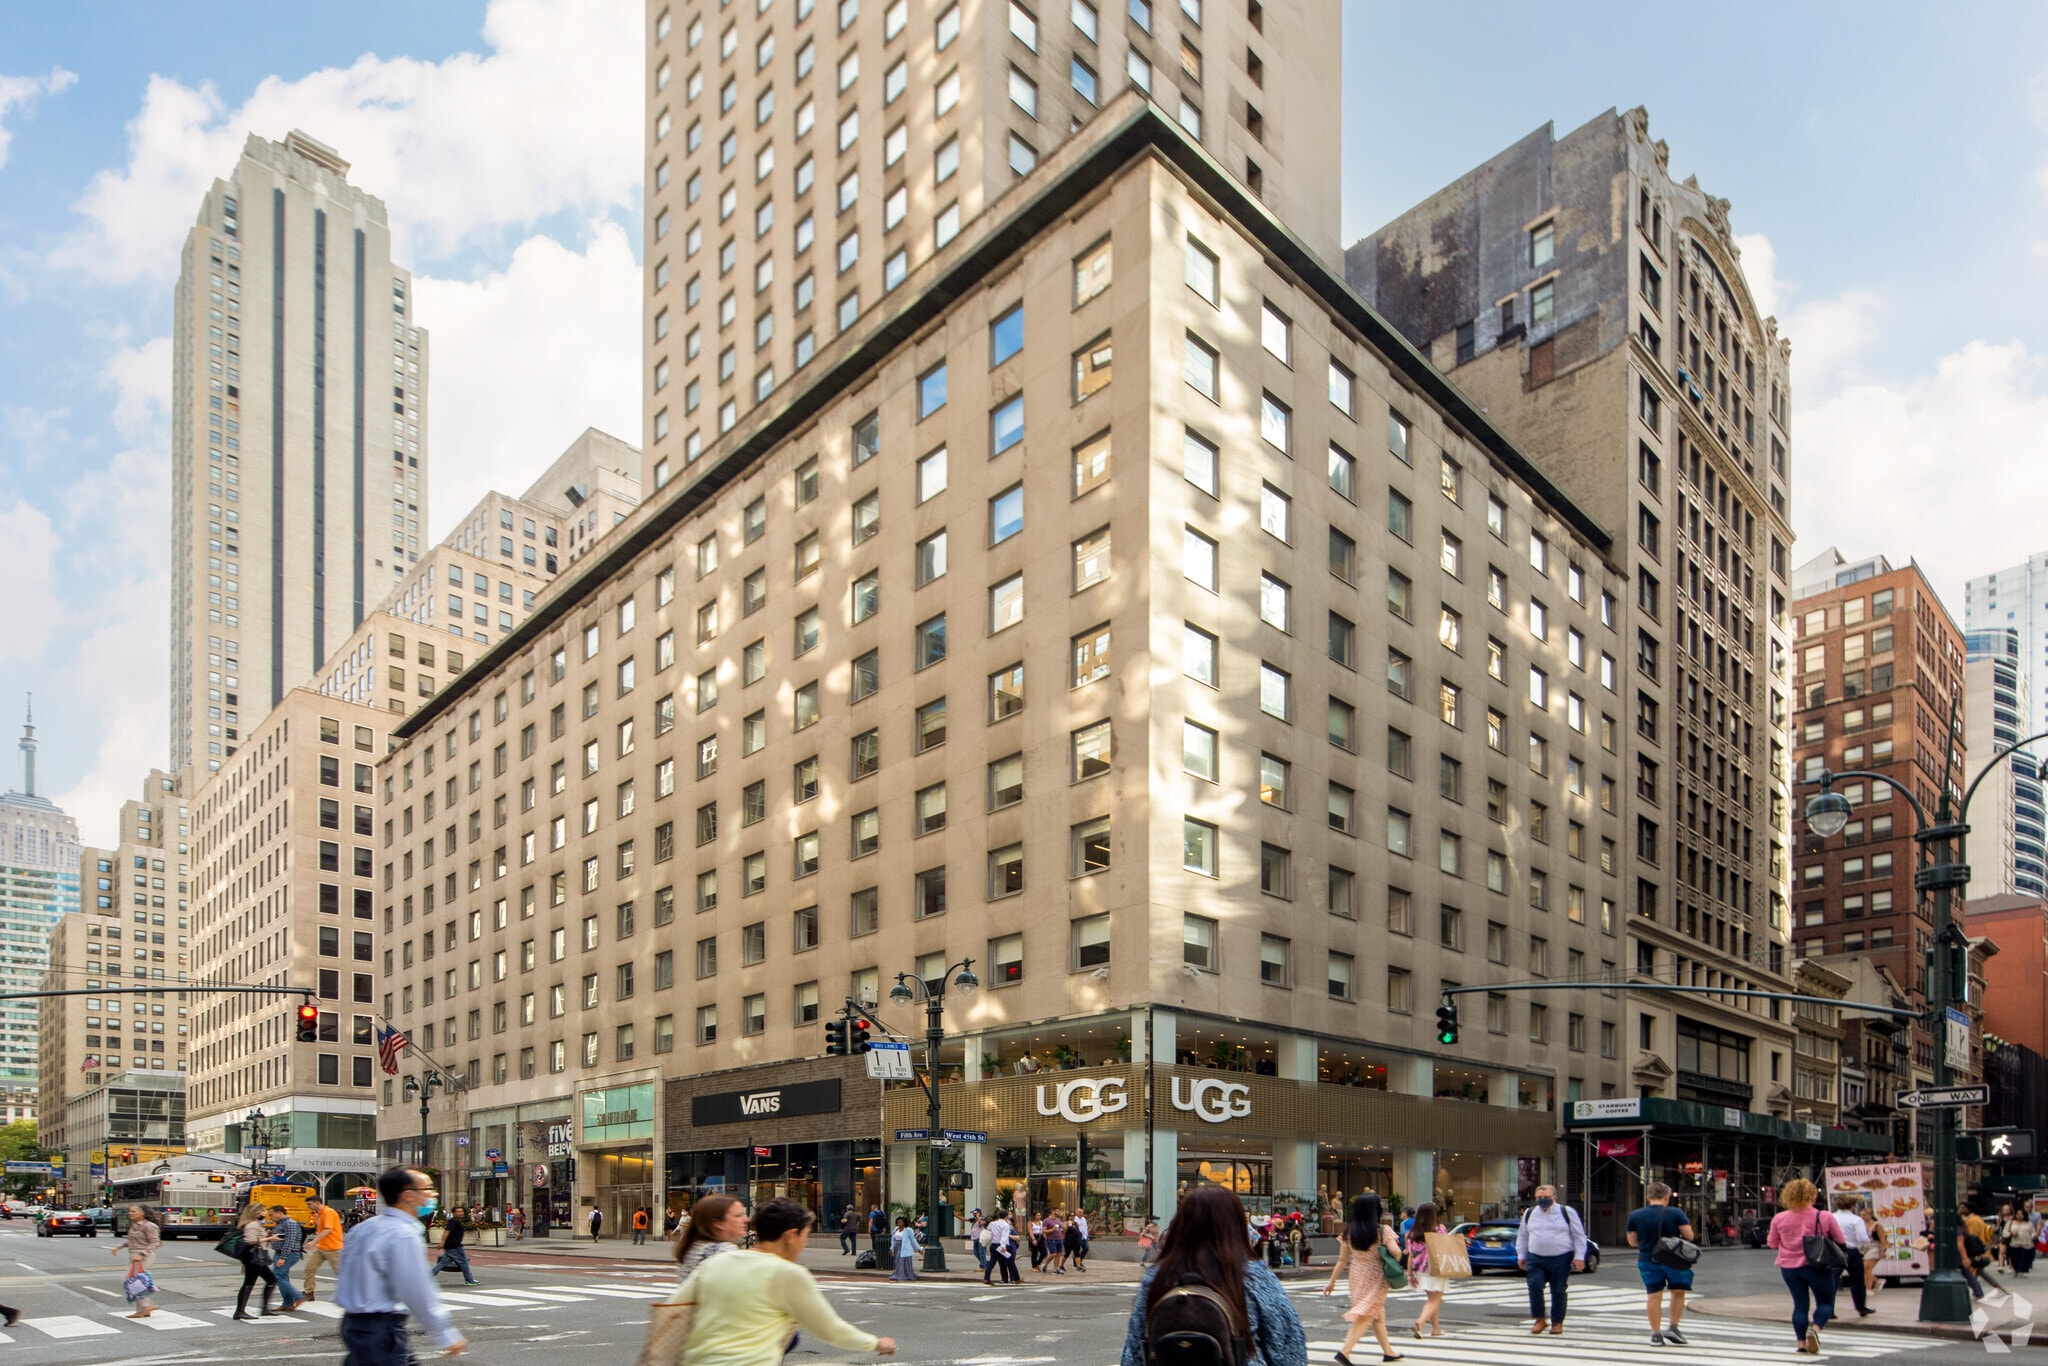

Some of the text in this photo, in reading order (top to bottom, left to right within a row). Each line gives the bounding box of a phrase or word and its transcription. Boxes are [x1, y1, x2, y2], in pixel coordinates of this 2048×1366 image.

[740, 1091, 781, 1115] VANS
[1036, 1077, 1128, 1123] UGG
[1171, 1076, 1252, 1123] UGG
[1908, 1090, 1979, 1103] ONE WAY
[1830, 1166, 1871, 1178] Smoothie
[1873, 1167, 1880, 1175] &
[1883, 1164, 1916, 1174] Croffle
